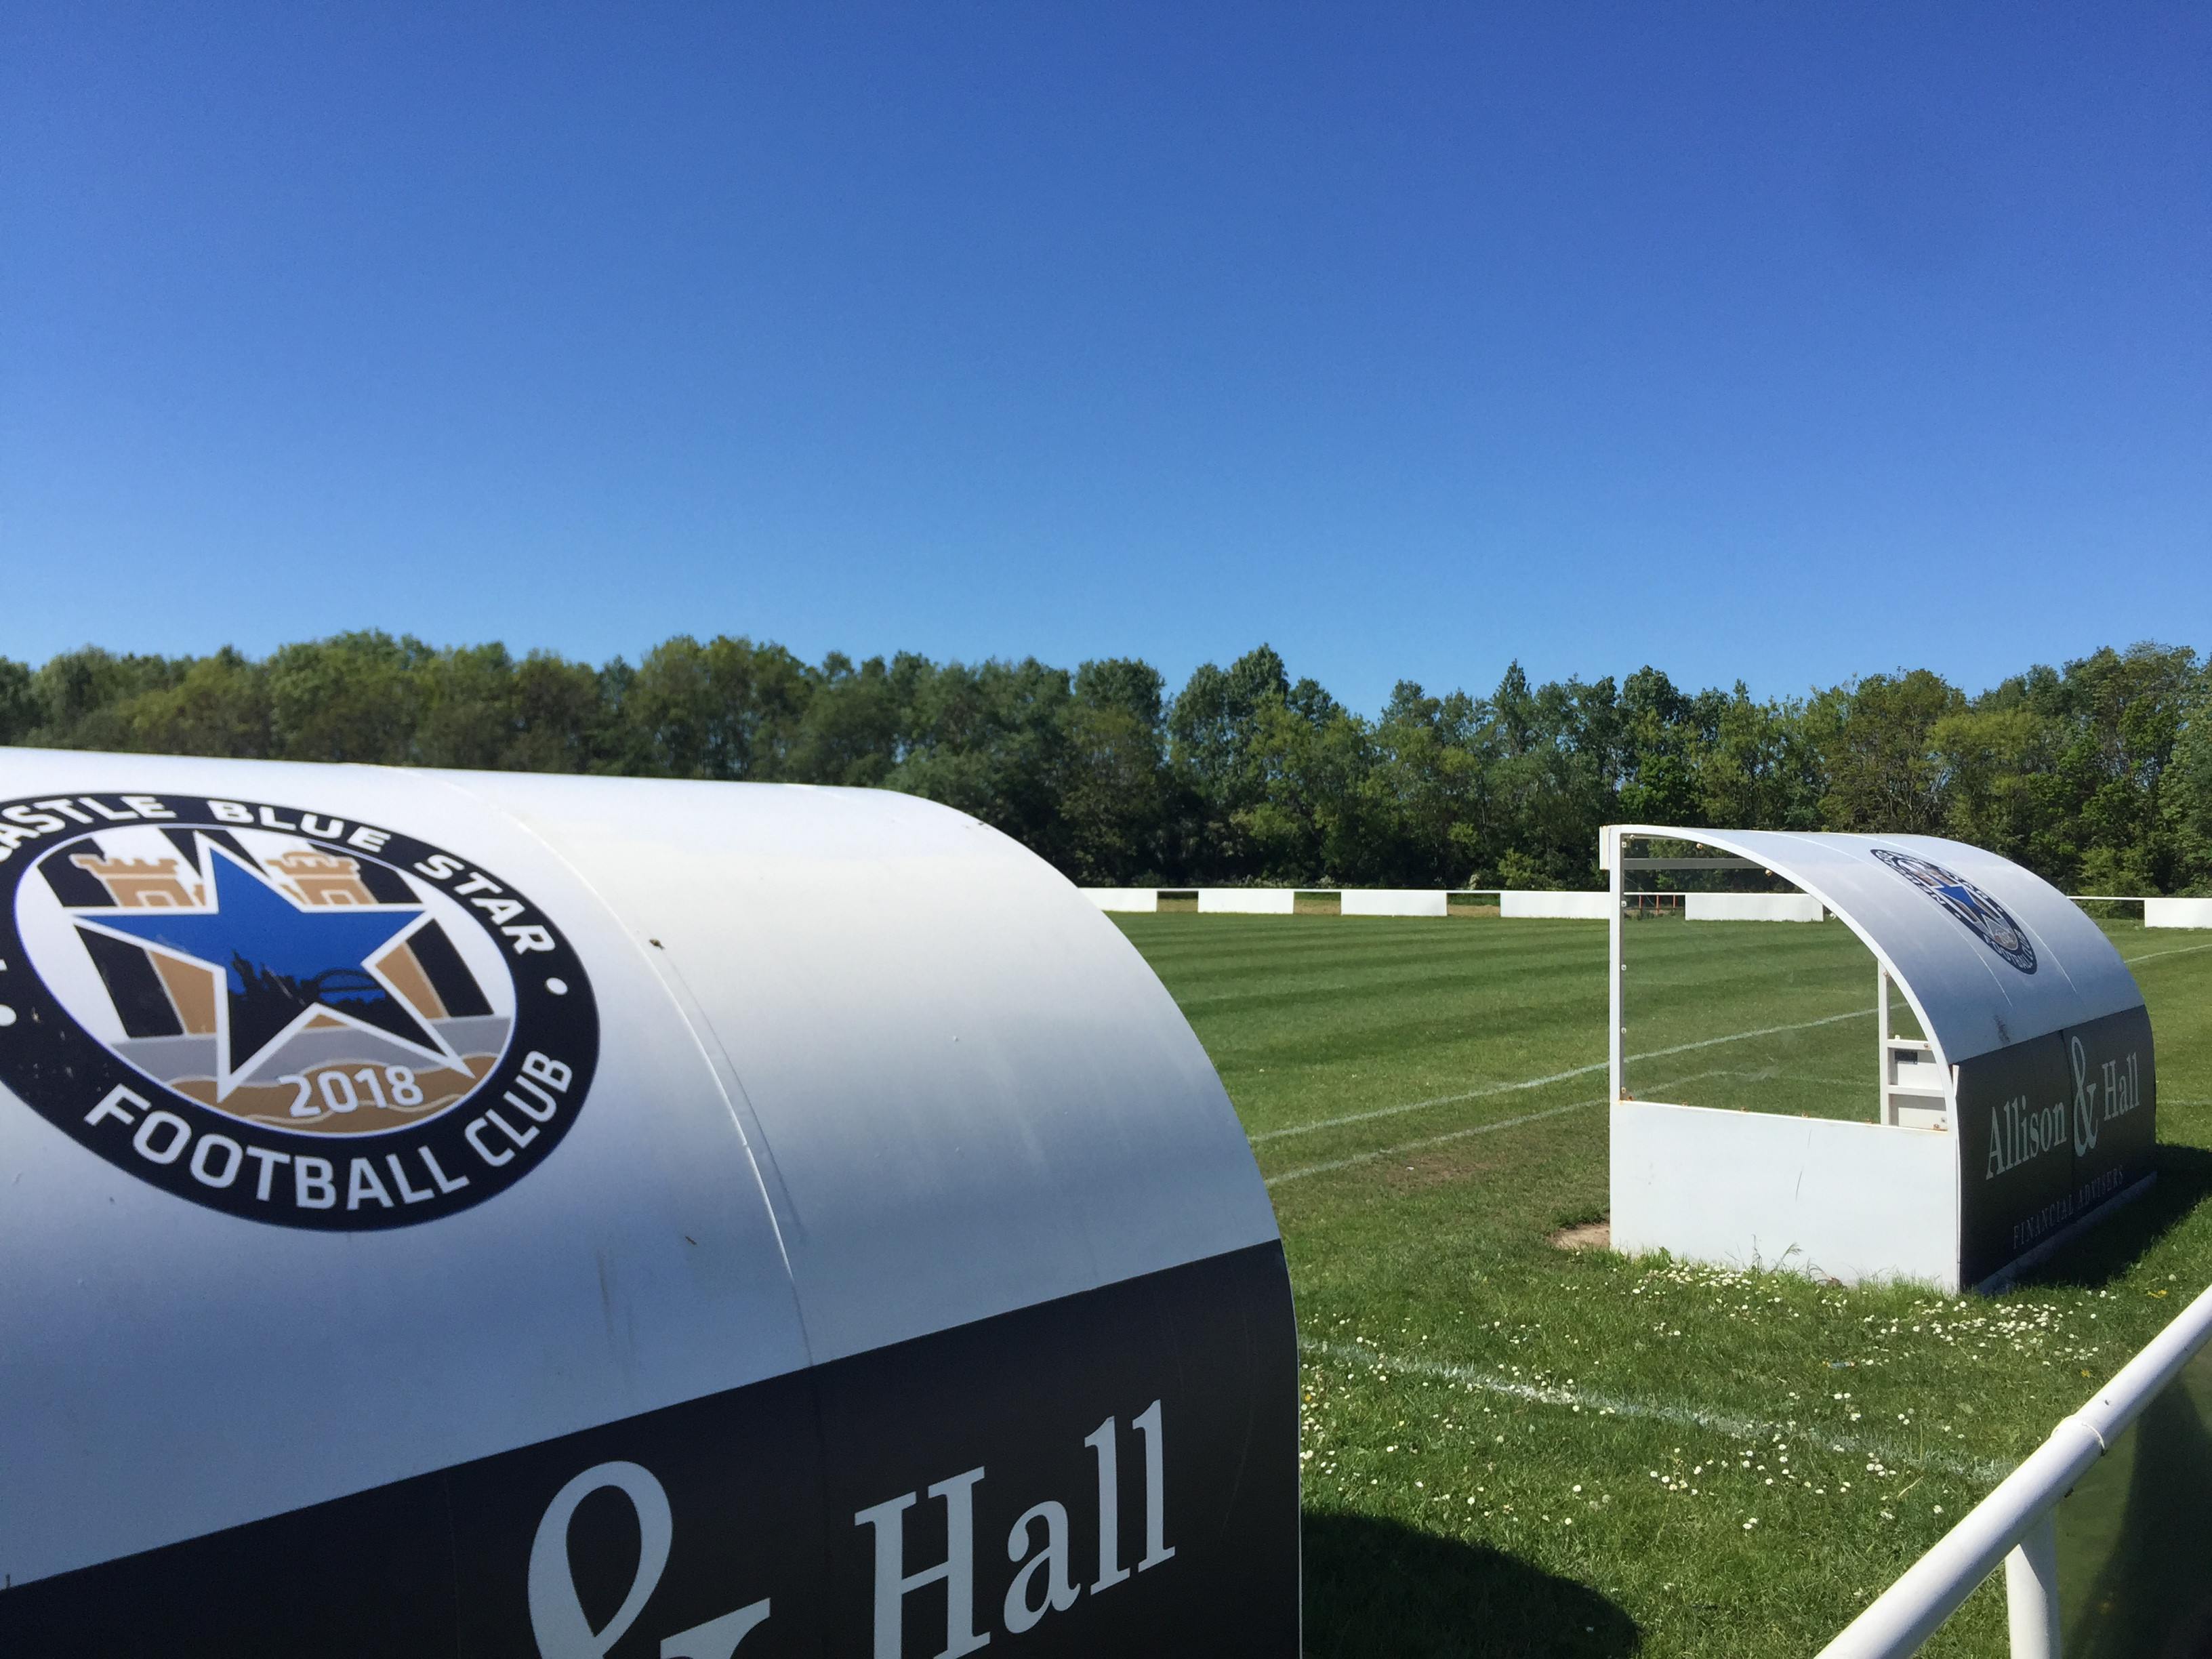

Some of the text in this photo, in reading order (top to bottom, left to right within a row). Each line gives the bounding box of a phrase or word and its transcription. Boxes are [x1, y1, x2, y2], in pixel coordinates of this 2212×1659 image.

[0, 796, 556, 956] ASTLE BLUE STAR
[84, 1050, 573, 1212] FOOTBALL CLUB
[279, 1065, 424, 1119] 2018
[1986, 1036, 2140, 1180] Allison & Hall
[854, 1399, 1176, 1659] Hall
